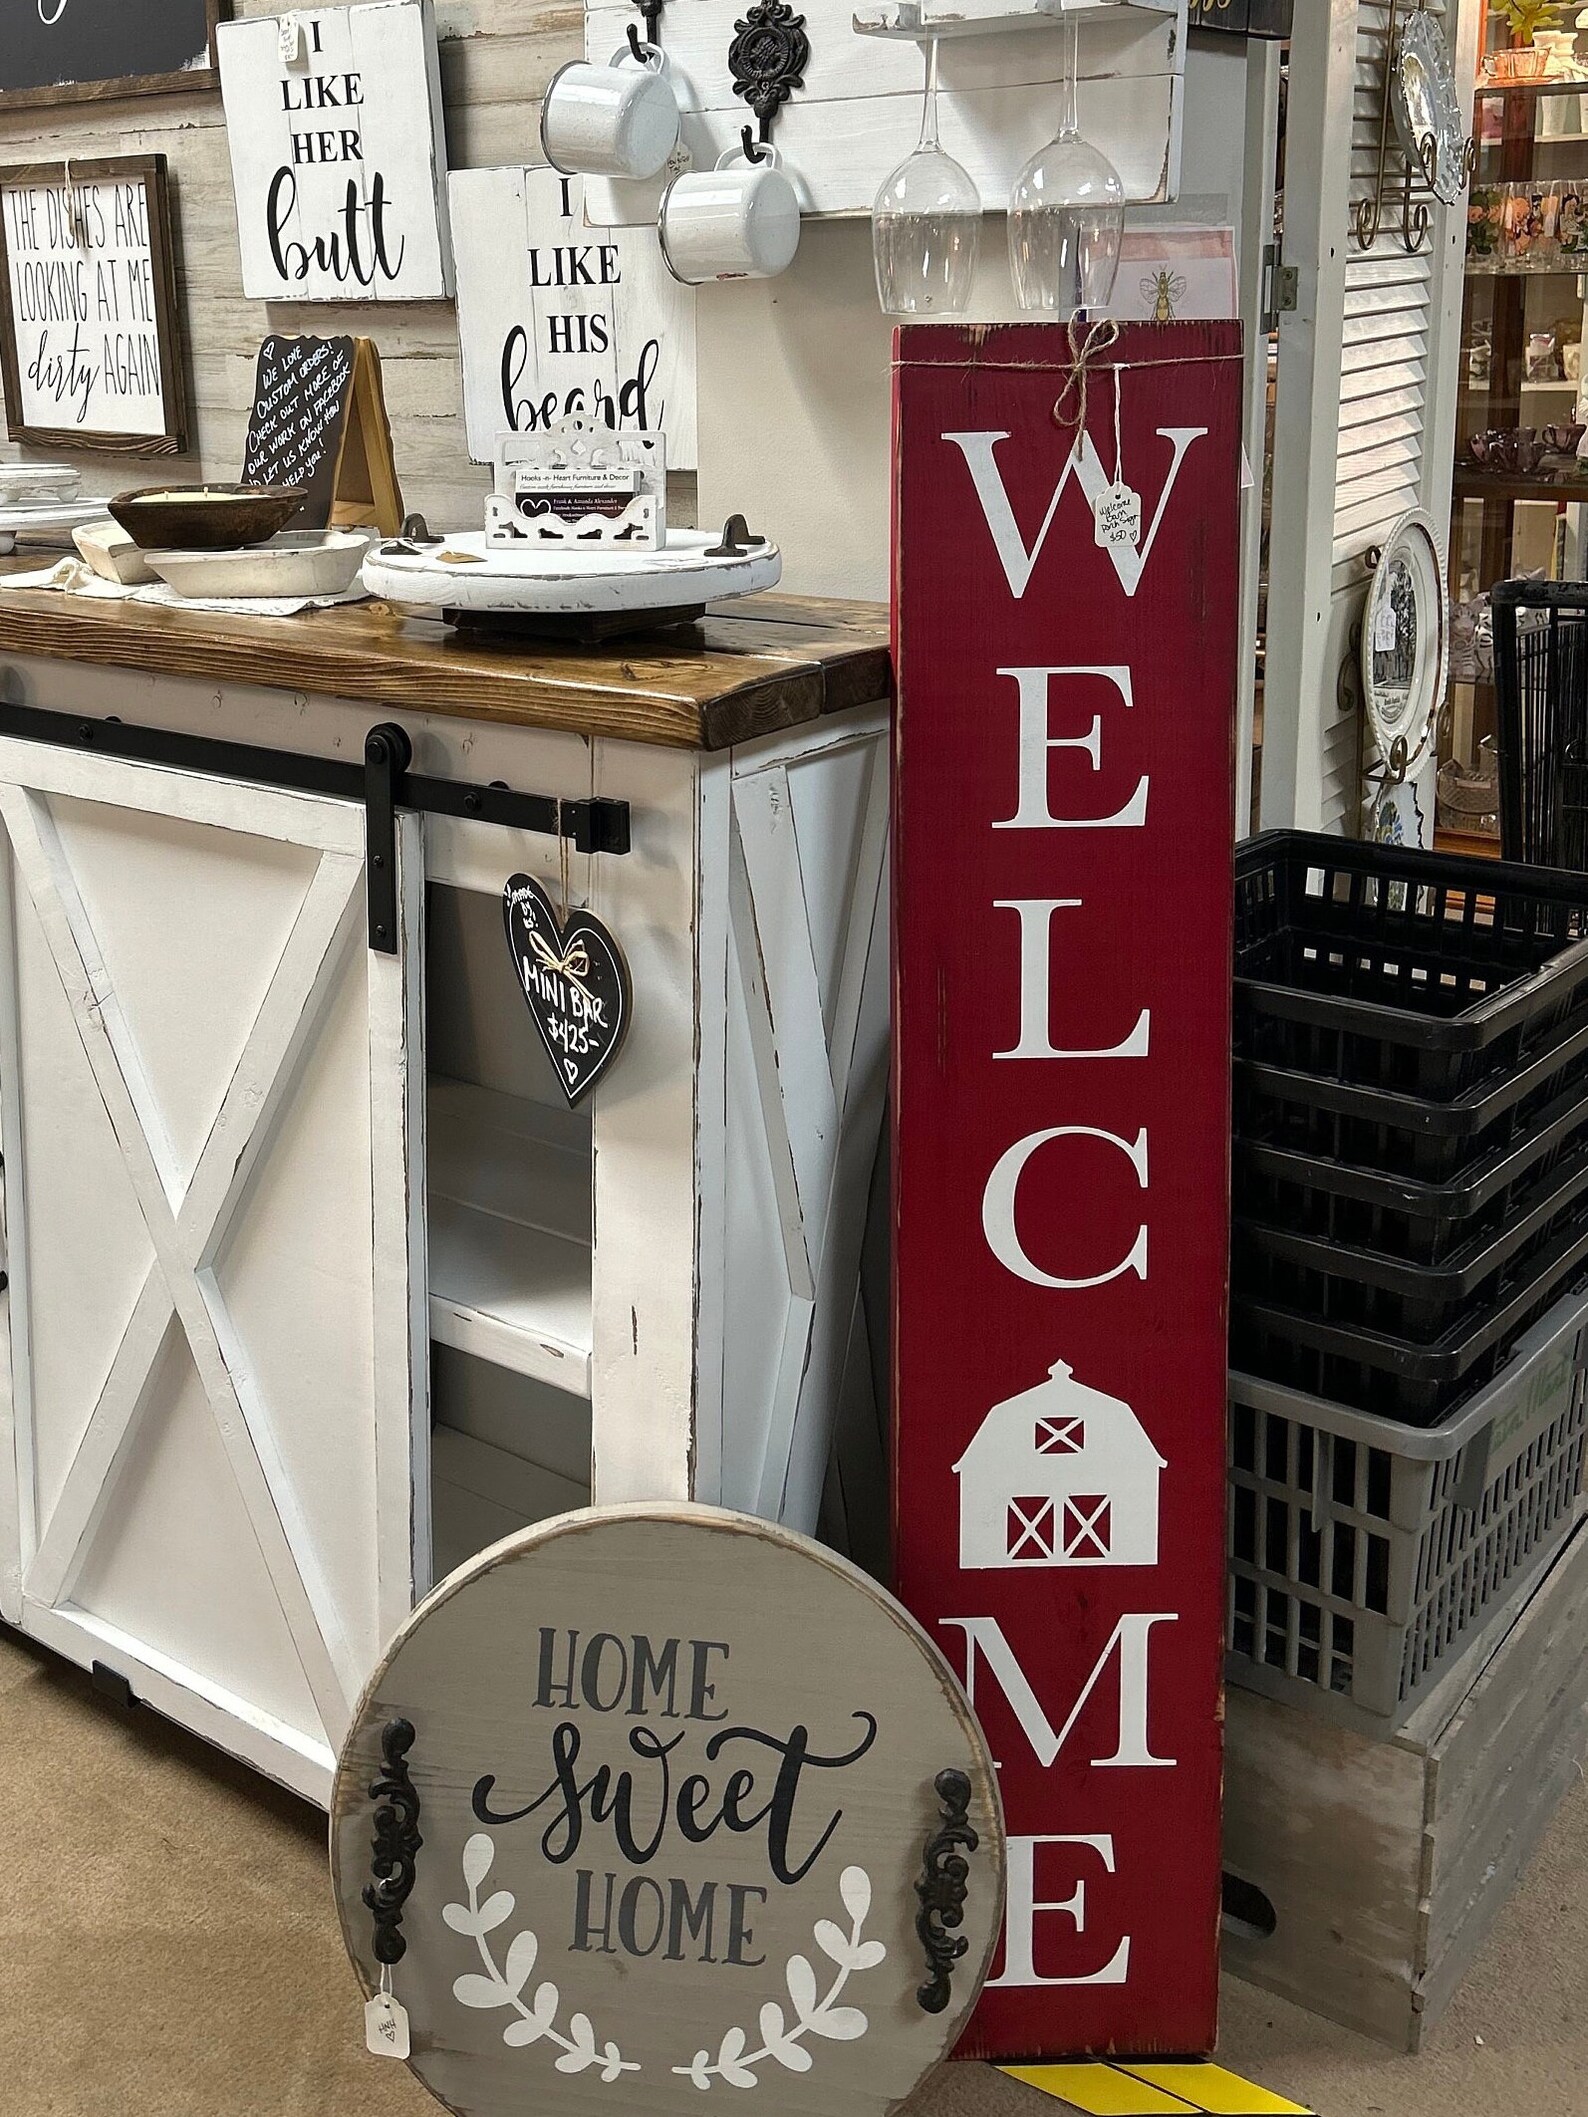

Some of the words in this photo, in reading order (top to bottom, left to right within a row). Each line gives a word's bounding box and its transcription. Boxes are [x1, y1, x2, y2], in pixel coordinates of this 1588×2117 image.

[310, 21, 322, 53] I
[281, 73, 365, 112] LIKE
[293, 129, 363, 164] HER
[9, 188, 39, 250] THE
[47, 185, 106, 250] DISHES
[115, 182, 148, 248] ARE
[267, 166, 405, 286] butt
[558, 178, 573, 217] I
[16, 261, 87, 322] LOOKING
[97, 260, 119, 322] AT
[128, 259, 153, 322] ME
[527, 244, 622, 287] LIKE
[262, 367, 278, 390] WE
[281, 345, 302, 371] LOVE
[547, 313, 609, 354] HIS
[28, 322, 100, 423] dirty
[104, 333, 160, 396] AGAIN
[248, 414, 278, 453] CHECK
[280, 396, 299, 419] OUT
[304, 366, 331, 401] MORE
[332, 350, 344, 371] OF
[257, 372, 299, 419] CUSTOM
[299, 341, 334, 378] ORDERS!
[248, 450, 269, 475] OUR
[269, 422, 297, 455] WORK
[299, 408, 312, 430] ON
[313, 361, 351, 417] FACEBOOK
[262, 461, 279, 485] LET
[282, 450, 297, 468] US
[298, 419, 323, 457] KNOW
[323, 400, 340, 424] HOW
[572, 473, 601, 481] Furniture
[602, 473, 608, 481] &
[609, 473, 629, 481] Decor
[1110, 529, 1127, 541] $50
[523, 956, 566, 1012] MINI
[569, 986, 609, 1031] BAR
[532, 1627, 730, 1721] HOME
[472, 1711, 877, 1885] sweet
[568, 1869, 767, 1966] HOME
